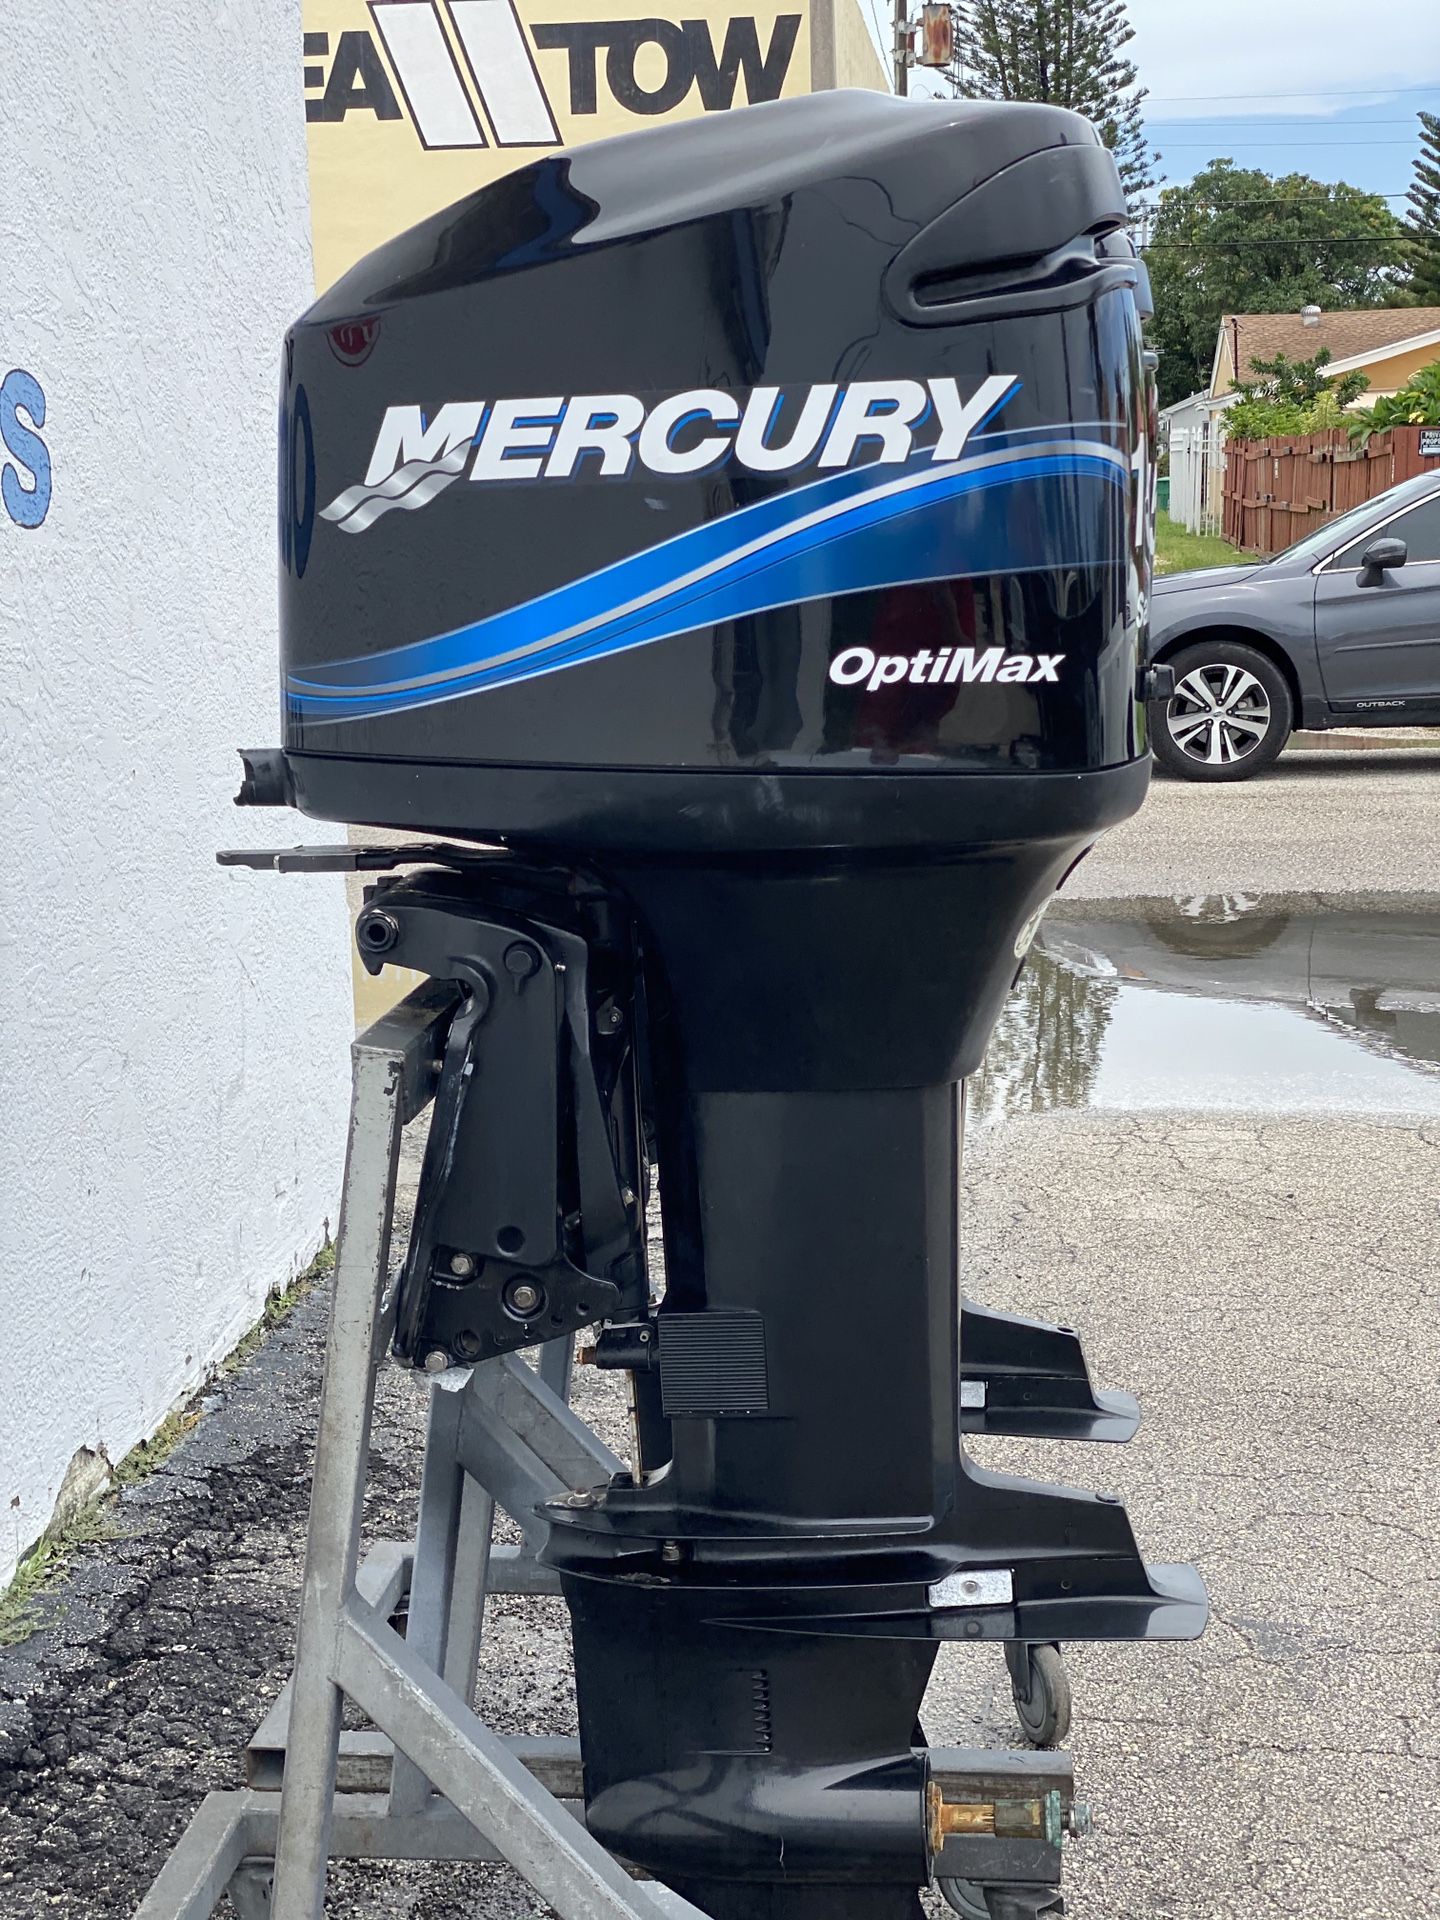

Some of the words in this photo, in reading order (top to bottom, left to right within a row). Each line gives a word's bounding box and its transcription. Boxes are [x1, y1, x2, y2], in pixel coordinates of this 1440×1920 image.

[530, 14, 802, 115] TOW
[0, 368, 52, 529] S
[364, 374, 1022, 487] MERCURY
[828, 646, 1067, 692] OptiMax
[1356, 700, 1406, 708] OUTBACK
